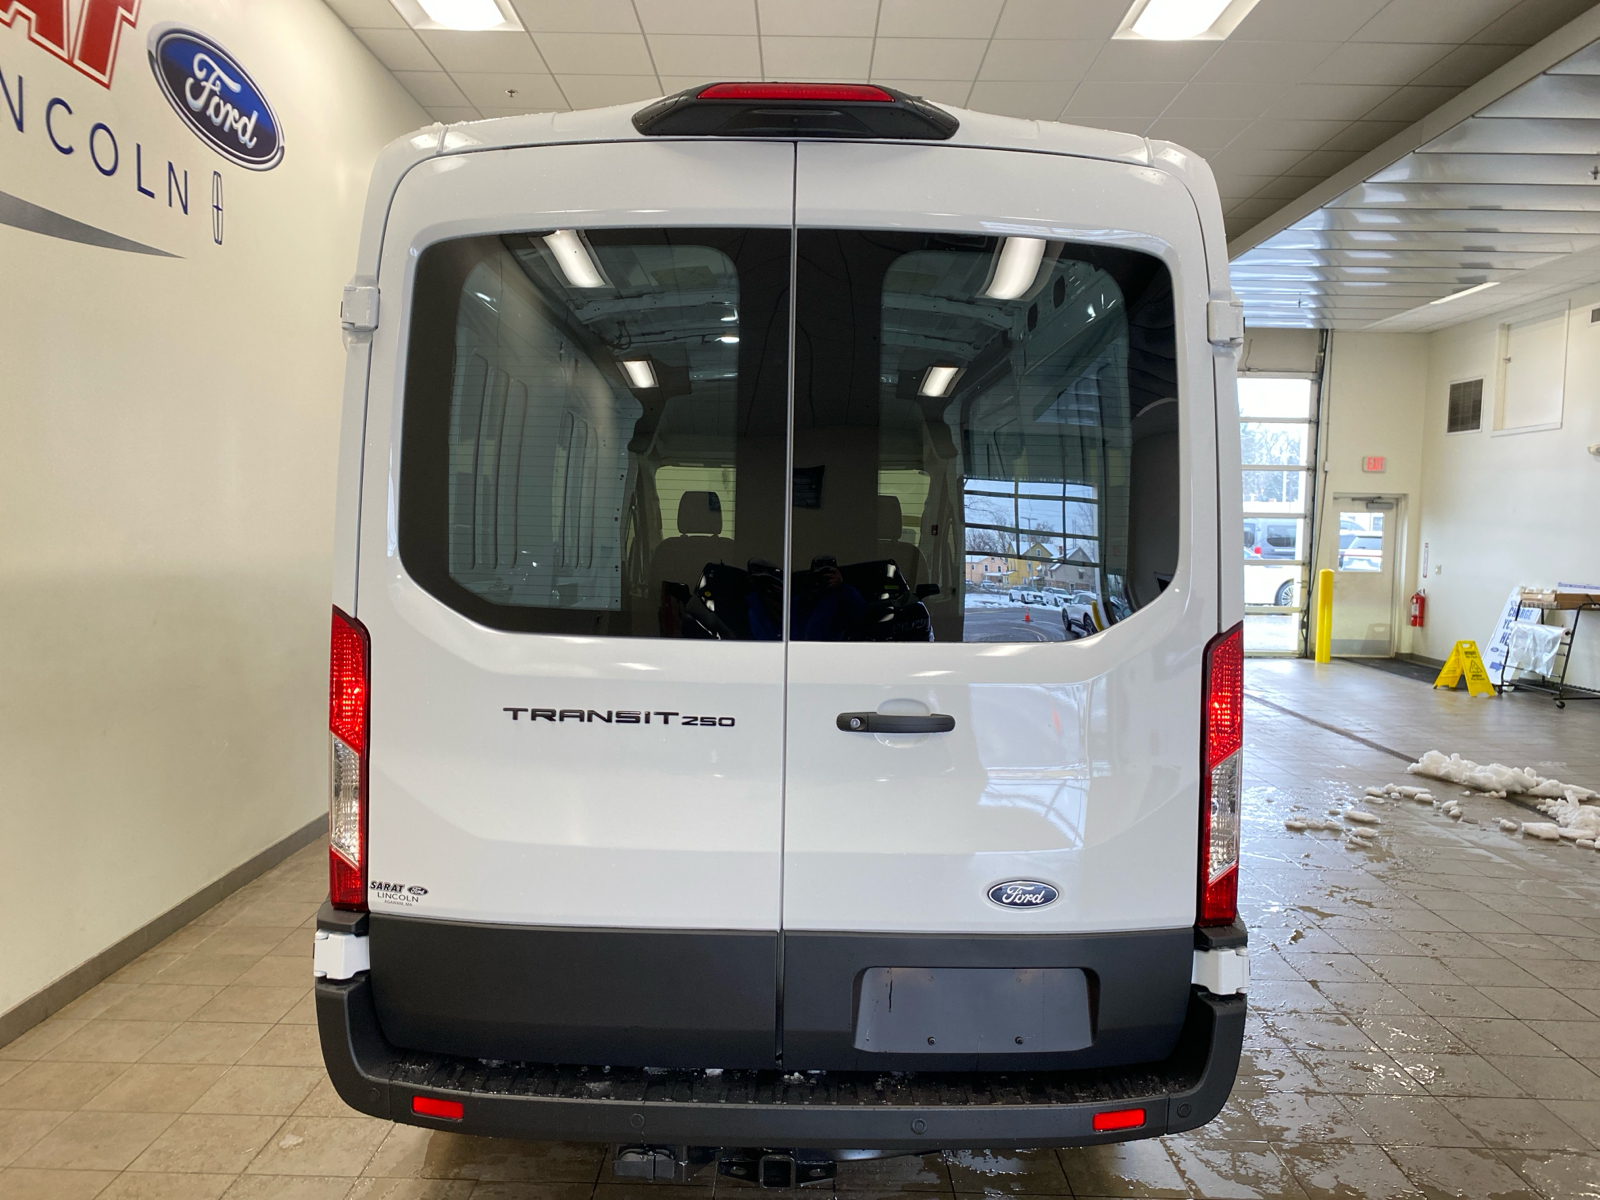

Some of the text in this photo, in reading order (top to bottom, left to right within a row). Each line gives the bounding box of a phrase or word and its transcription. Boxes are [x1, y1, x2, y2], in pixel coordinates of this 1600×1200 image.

[184, 52, 257, 149] Ford
[1367, 456, 1384, 470] EXIT
[1507, 606, 1534, 620] CHRGE
[502, 707, 736, 727] TRANSIT 250
[370, 880, 405, 893] SARAT
[377, 891, 419, 903] LINCOLN
[1002, 885, 1045, 903] Ford
